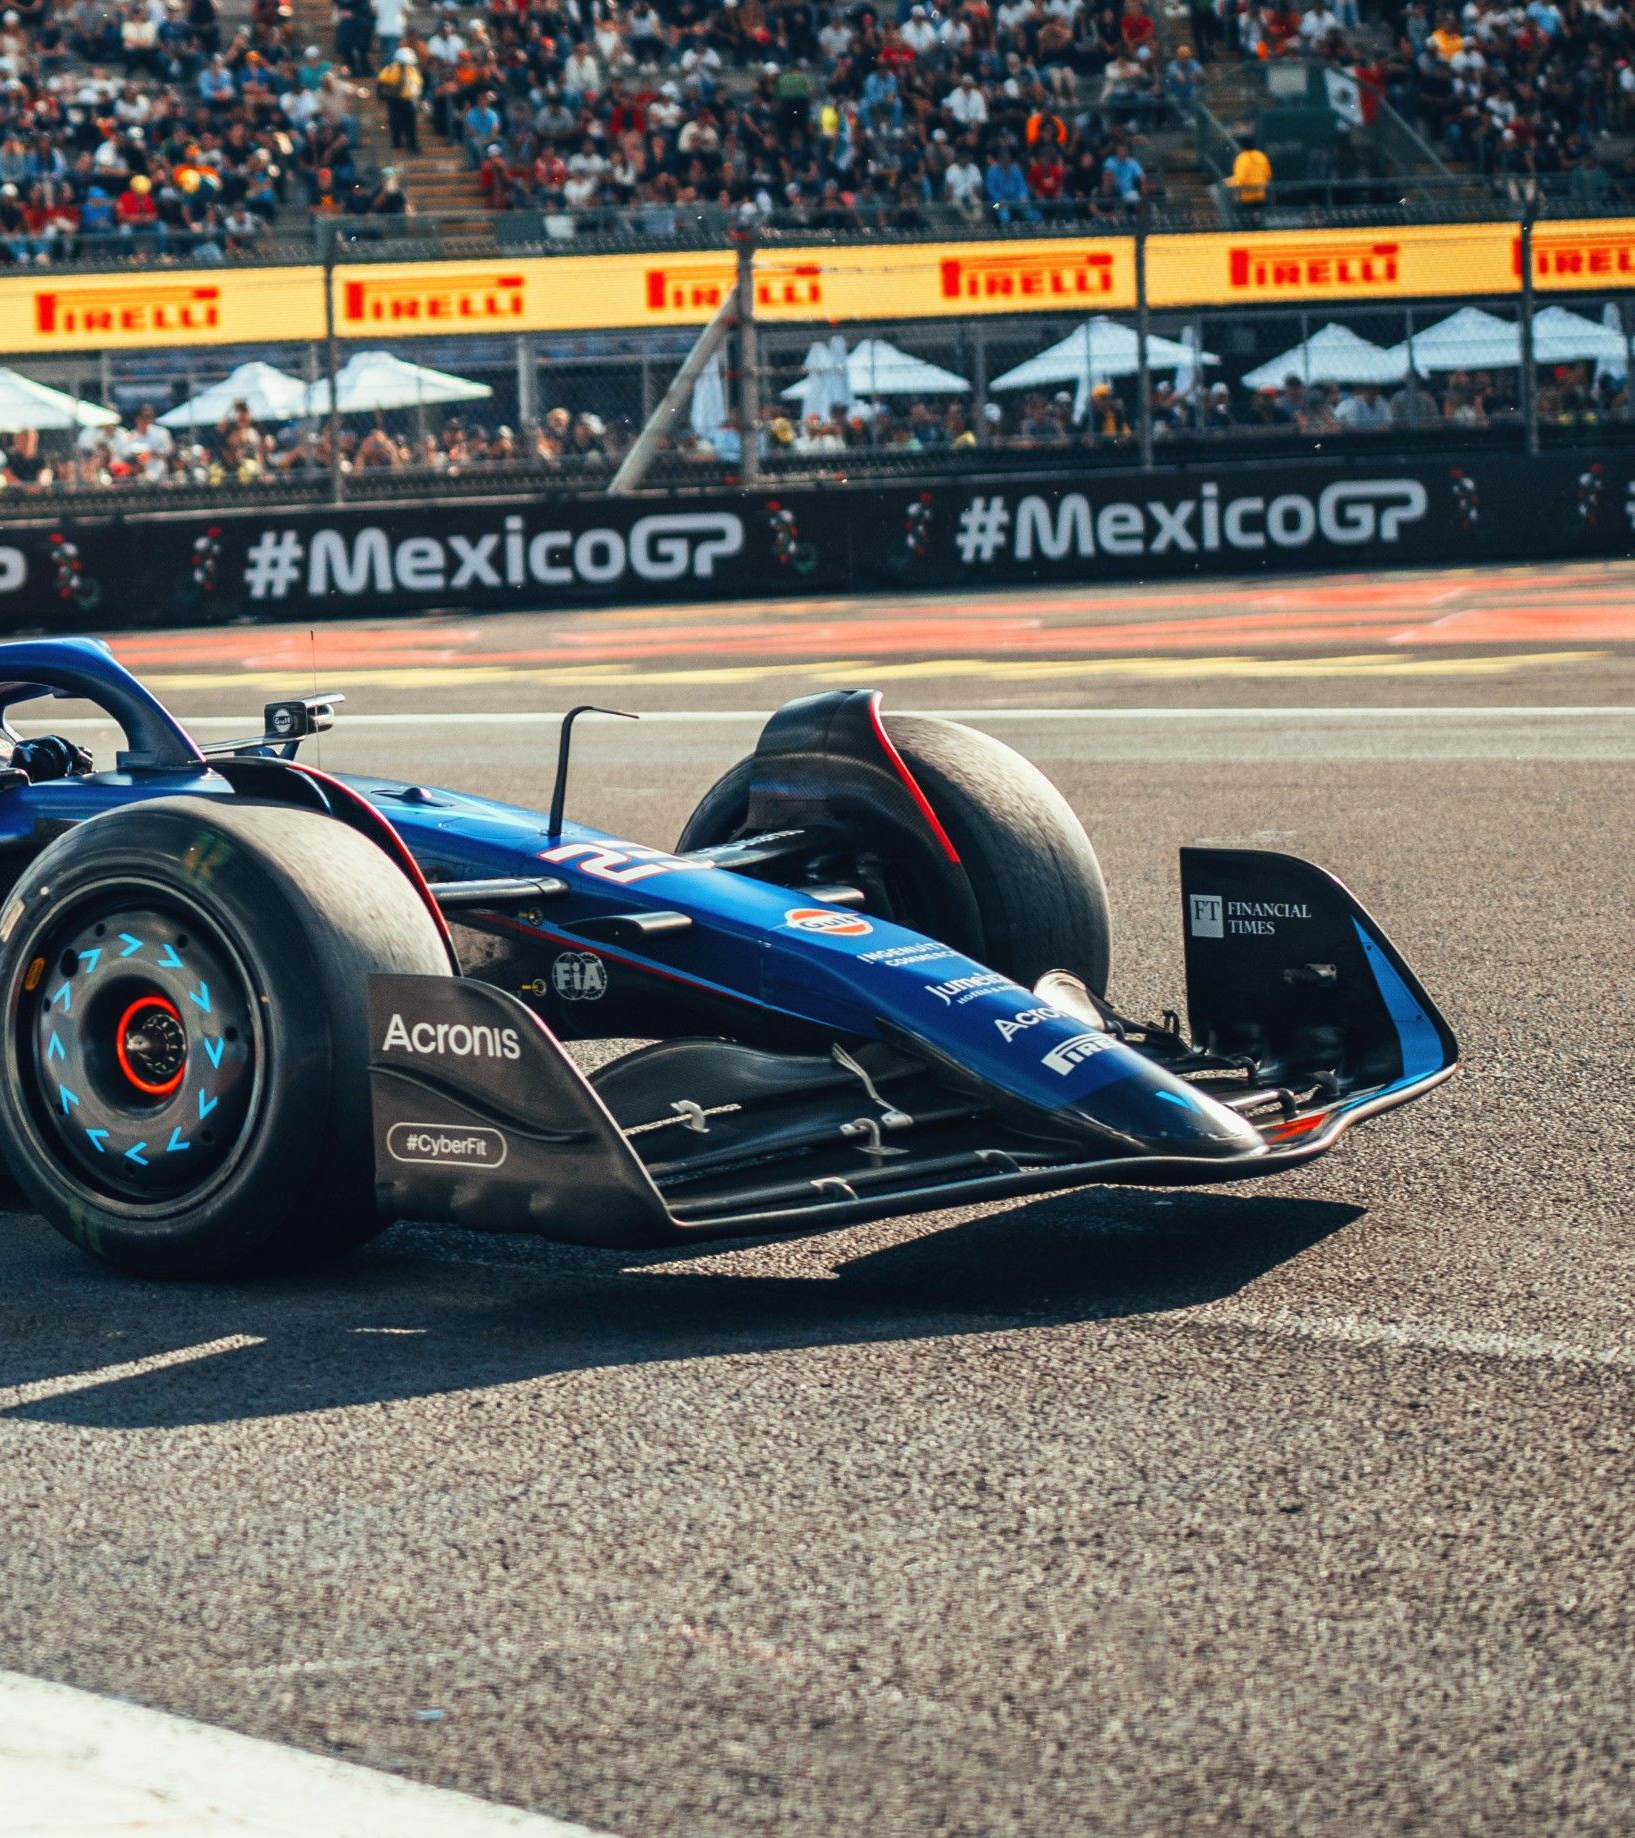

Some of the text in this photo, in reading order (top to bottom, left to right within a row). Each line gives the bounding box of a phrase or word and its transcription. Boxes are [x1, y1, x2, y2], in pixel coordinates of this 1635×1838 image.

[647, 262, 821, 309] PIRLLI
[941, 253, 1113, 298] PIRELLI
[1230, 243, 1399, 287] PIRELLI
[36, 286, 219, 333] PIRELLI
[345, 275, 524, 320] PIRELLI
[956, 479, 1428, 563] #MexicoGP
[244, 511, 743, 598] #MexicoGP
[1194, 900, 1220, 921] FT
[1228, 901, 1312, 918] FINANCIAL
[1228, 919, 1276, 935] TIMES
[382, 1013, 521, 1060] Acronis
[994, 1007, 1068, 1043] Acro
[406, 1134, 488, 1157] #CyberFit
